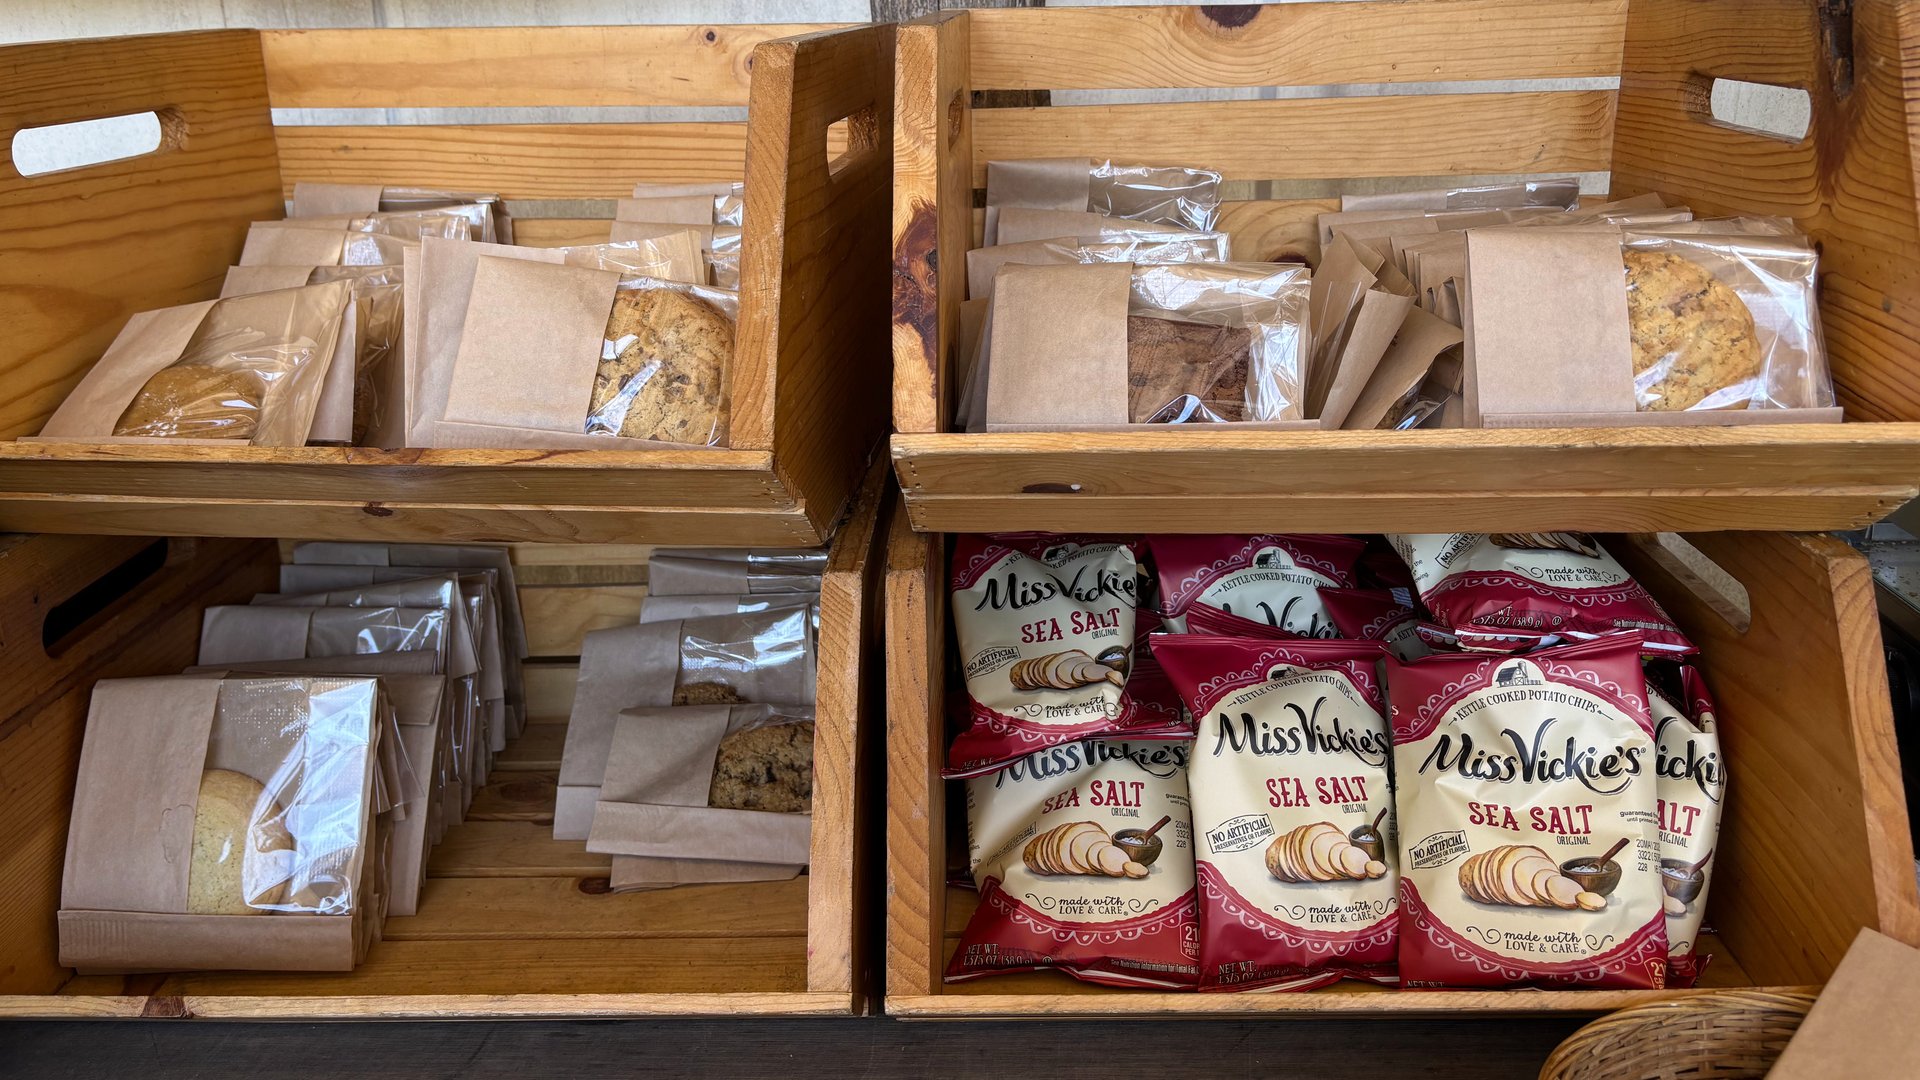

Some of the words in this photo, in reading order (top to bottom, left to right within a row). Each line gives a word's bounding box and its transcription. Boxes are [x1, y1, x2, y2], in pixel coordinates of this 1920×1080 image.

[1545, 566, 1575, 575] made
[1576, 566, 1600, 576] with
[1548, 574, 1574, 582] LOVE
[1576, 574, 1583, 582] &
[1221, 574, 1251, 592] KETTLE
[1250, 572, 1280, 582] COOKED
[1281, 572, 1312, 585] POTATO
[975, 572, 1057, 611] Miss
[1021, 619, 1064, 644] SEA
[1070, 607, 1121, 635] SALT
[966, 662, 977, 673] NO
[1235, 687, 1267, 705] KETTLE
[1266, 677, 1301, 692] COOKED
[1302, 675, 1335, 685] POTATO
[1335, 679, 1352, 698] CHIPS
[1045, 700, 1076, 710] made
[1046, 707, 1071, 718] LOVE
[1074, 708, 1081, 716] &
[1456, 697, 1487, 720] KETTLE
[1487, 690, 1527, 706] COOKED
[1529, 690, 1567, 704] POTATO
[1568, 695, 1599, 714] CHIPS
[1213, 712, 1302, 757] Miss
[1284, 696, 1389, 768] Vickie's
[1418, 733, 1519, 784] Miss
[1500, 718, 1642, 796] Vickie's
[1042, 788, 1080, 815] SEA
[1090, 780, 1144, 808] SALT
[1266, 777, 1310, 807] SEA
[1315, 776, 1368, 804] SALT
[1111, 807, 1140, 818] ORIGINAL
[1468, 802, 1520, 831] SEA
[1529, 805, 1593, 835] SALT
[1657, 798, 1701, 836] ALT
[1212, 831, 1225, 844] NO
[1227, 817, 1270, 840] ARTIFICIAL
[1413, 848, 1425, 860] NO
[1426, 834, 1465, 857] ARTIFICIAL
[1556, 834, 1591, 846] ORIGINAL
[1658, 831, 1688, 848] RIGINAL
[1058, 896, 1091, 907] made
[1093, 896, 1126, 906] with
[1309, 904, 1342, 914] made
[1344, 901, 1372, 912] with
[1059, 905, 1085, 915] LOVE
[1087, 905, 1094, 914] &
[1098, 905, 1123, 915] CARE
[1310, 914, 1336, 923] LOVE
[1340, 914, 1348, 923] &
[1351, 910, 1372, 922] CARE
[1185, 925, 1200, 942] 21
[1504, 931, 1541, 942] made
[1543, 931, 1581, 943] with
[965, 944, 983, 954] NET
[1506, 940, 1535, 952] LOVE
[1539, 943, 1547, 953] &
[1551, 943, 1580, 953] CARE
[1218, 962, 1236, 975] NET
[1239, 960, 1257, 973] WT.
